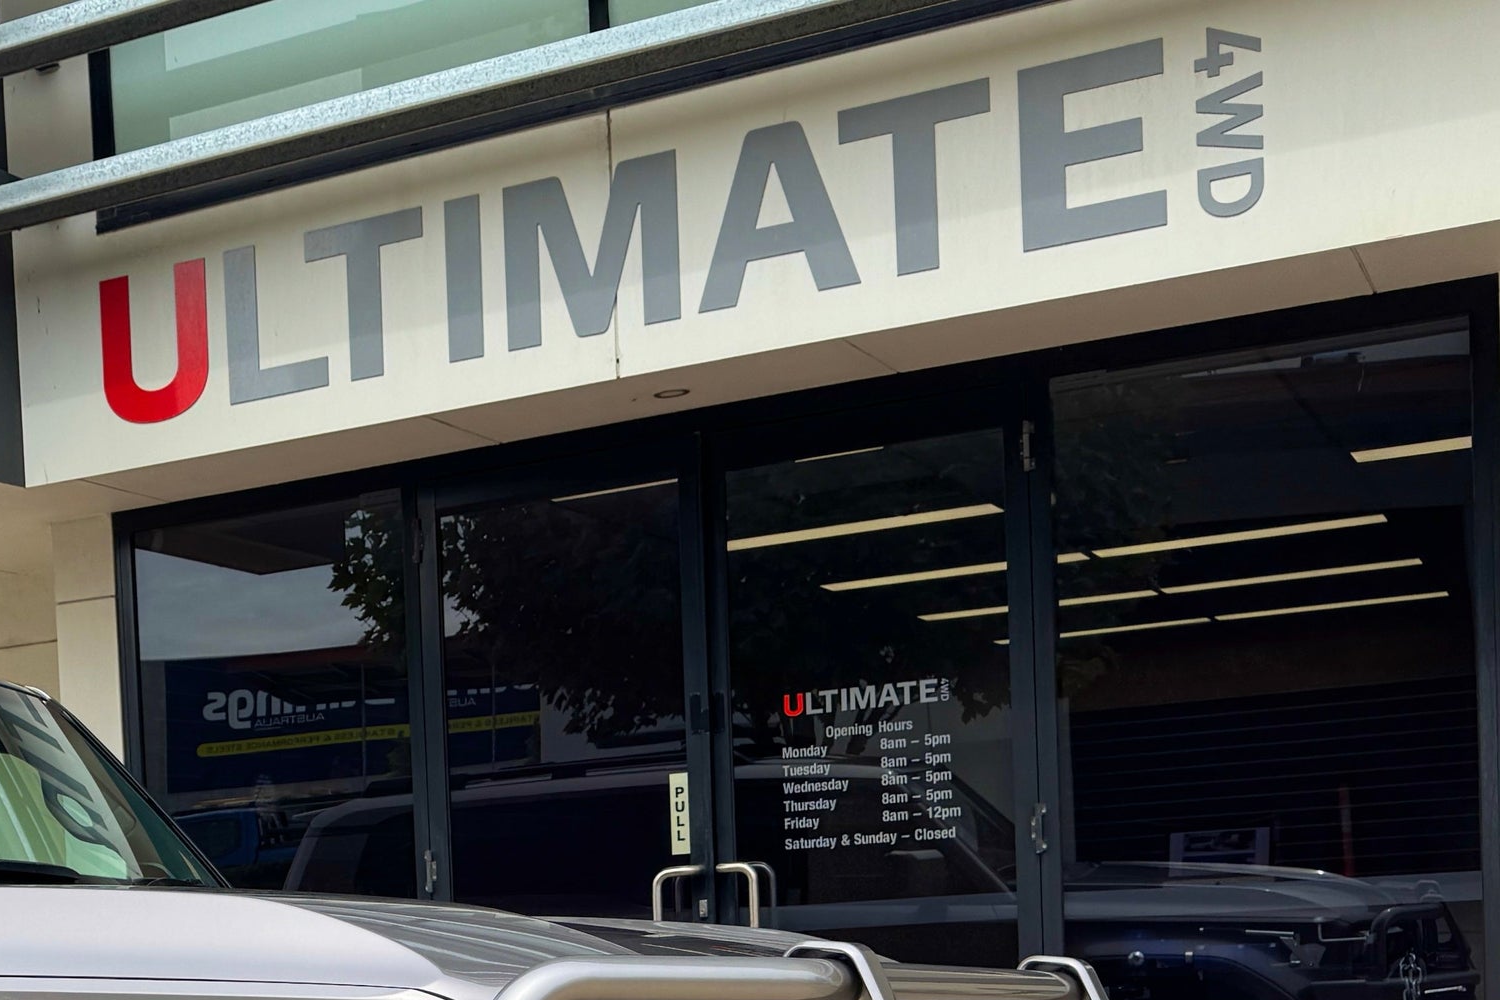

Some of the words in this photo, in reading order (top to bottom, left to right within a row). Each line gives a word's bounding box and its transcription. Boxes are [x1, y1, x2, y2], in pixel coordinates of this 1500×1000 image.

[1194, 26, 1265, 218] 4WD
[99, 37, 1167, 424] ULTIMATE
[783, 678, 939, 717] ULTIMATE
[940, 677, 950, 701] 4WD
[825, 722, 873, 739] Opening
[878, 720, 914, 733] Hours
[782, 745, 828, 759] Monday
[880, 737, 907, 750] 8am
[924, 733, 951, 746] 5pm
[782, 763, 830, 777] Tuesday
[881, 756, 907, 769] 8am
[925, 752, 951, 765] 5pm
[783, 779, 849, 794] Wednesday
[881, 774, 908, 786] 8am
[925, 770, 952, 782] 5pm
[783, 799, 837, 813] Thursday
[882, 792, 908, 804] 8am
[926, 788, 953, 801] 5pm
[675, 786, 686, 842] PULL
[784, 817, 820, 830] Friday
[882, 810, 909, 822] 8am
[926, 805, 962, 819] 12pm
[785, 836, 837, 850] Saturday
[841, 834, 851, 846] &
[854, 831, 897, 845] Sunday
[914, 826, 956, 841] Closed
